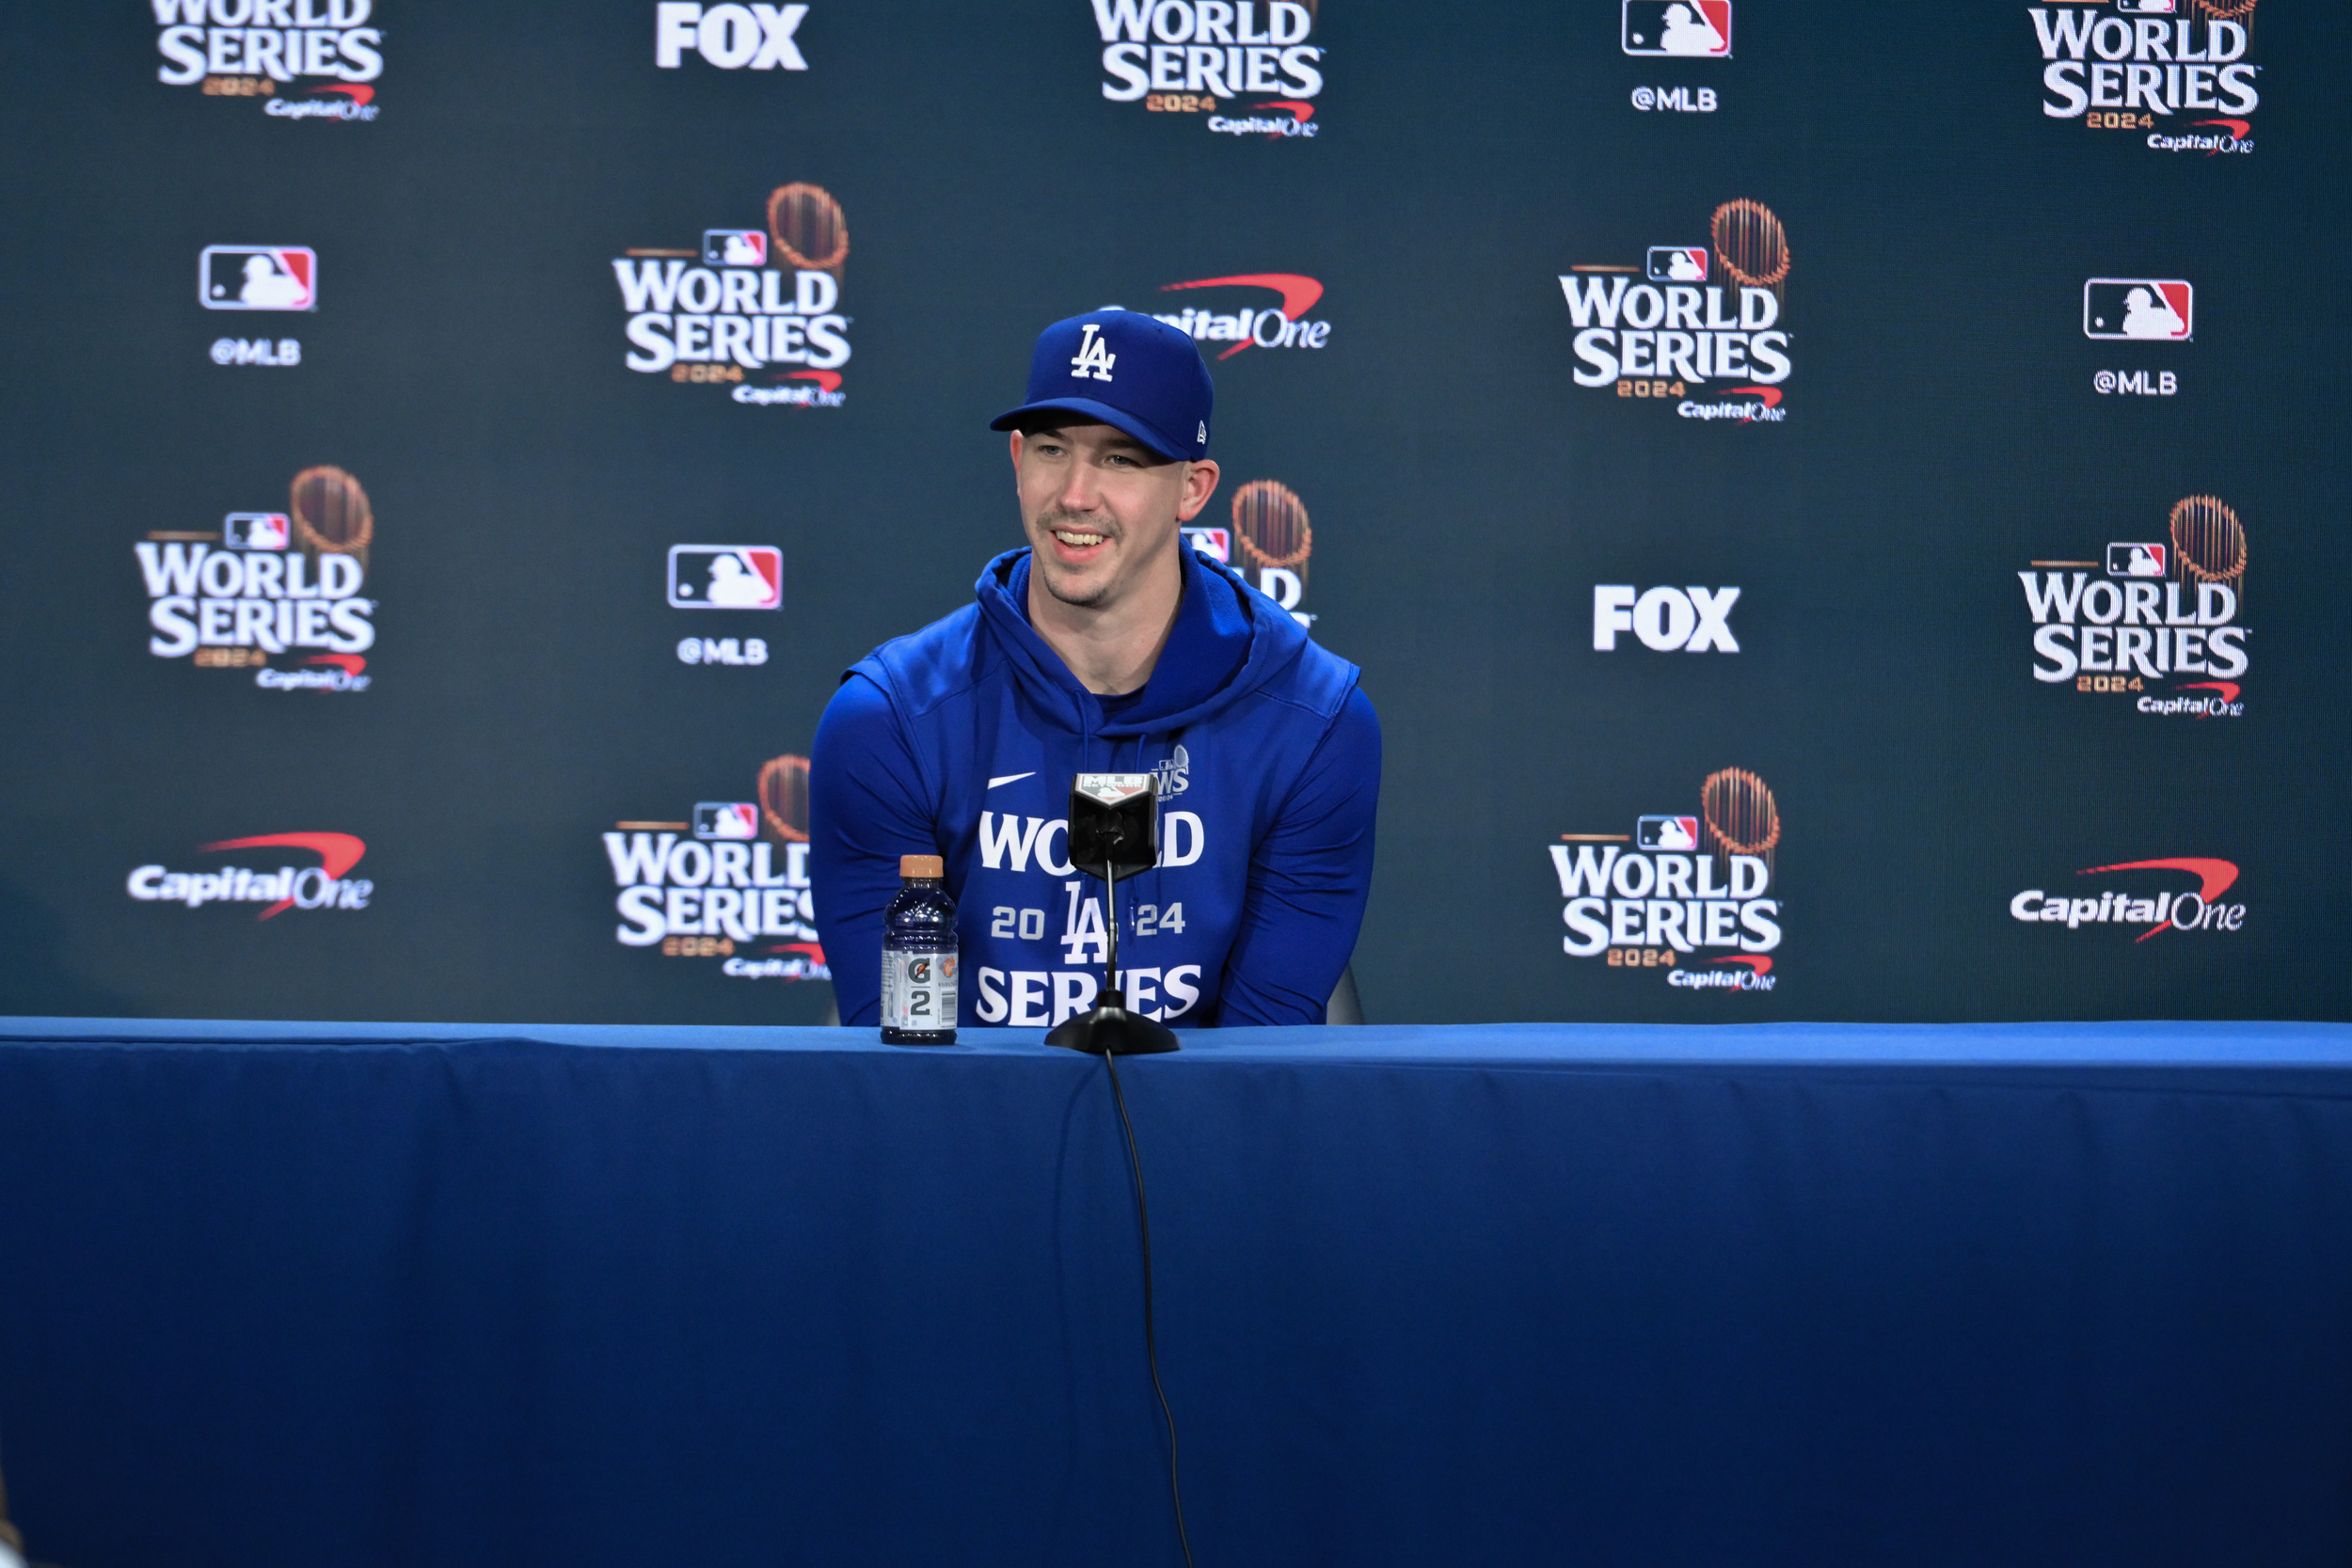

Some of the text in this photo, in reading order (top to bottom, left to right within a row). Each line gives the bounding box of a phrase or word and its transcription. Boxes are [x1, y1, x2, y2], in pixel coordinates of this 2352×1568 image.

[656, 1, 809, 71] FOX
[1091, 0, 1311, 44] WORLD
[2027, 8, 2248, 62] WORLD
[158, 24, 384, 85] SERIES
[1103, 43, 1324, 101] SERIES
[1146, 95, 1216, 112] 2024
[1631, 86, 1718, 112] @MLB
[2042, 60, 2259, 118] SERIES
[2086, 112, 2154, 129] 2024
[612, 259, 838, 314] WORLD
[1558, 276, 1778, 329] WORLD
[210, 339, 301, 366] @MLB
[626, 312, 851, 372] SERIES
[1071, 324, 1116, 382] LA
[1572, 328, 1791, 388] SERIES
[1617, 381, 1686, 398] 2024
[2093, 370, 2178, 396] @MLB
[135, 542, 363, 599] WORLD
[150, 595, 375, 657] SERIES
[1593, 585, 1740, 653] FOX
[2018, 572, 2236, 626] WORLD
[676, 637, 769, 666] @MLB
[2033, 624, 2249, 683] SERIES
[2076, 675, 2144, 692] 2024
[1083, 776, 1143, 784] MLB
[1149, 768, 1189, 796] WS
[979, 810, 1205, 876] WOD
[1549, 846, 1769, 899] WORLD
[991, 880, 1186, 965] 20 LA 24
[1563, 897, 1781, 957] SERIES
[908, 958, 931, 983] G
[1607, 948, 1676, 966] 2024
[911, 990, 930, 1016] 2
